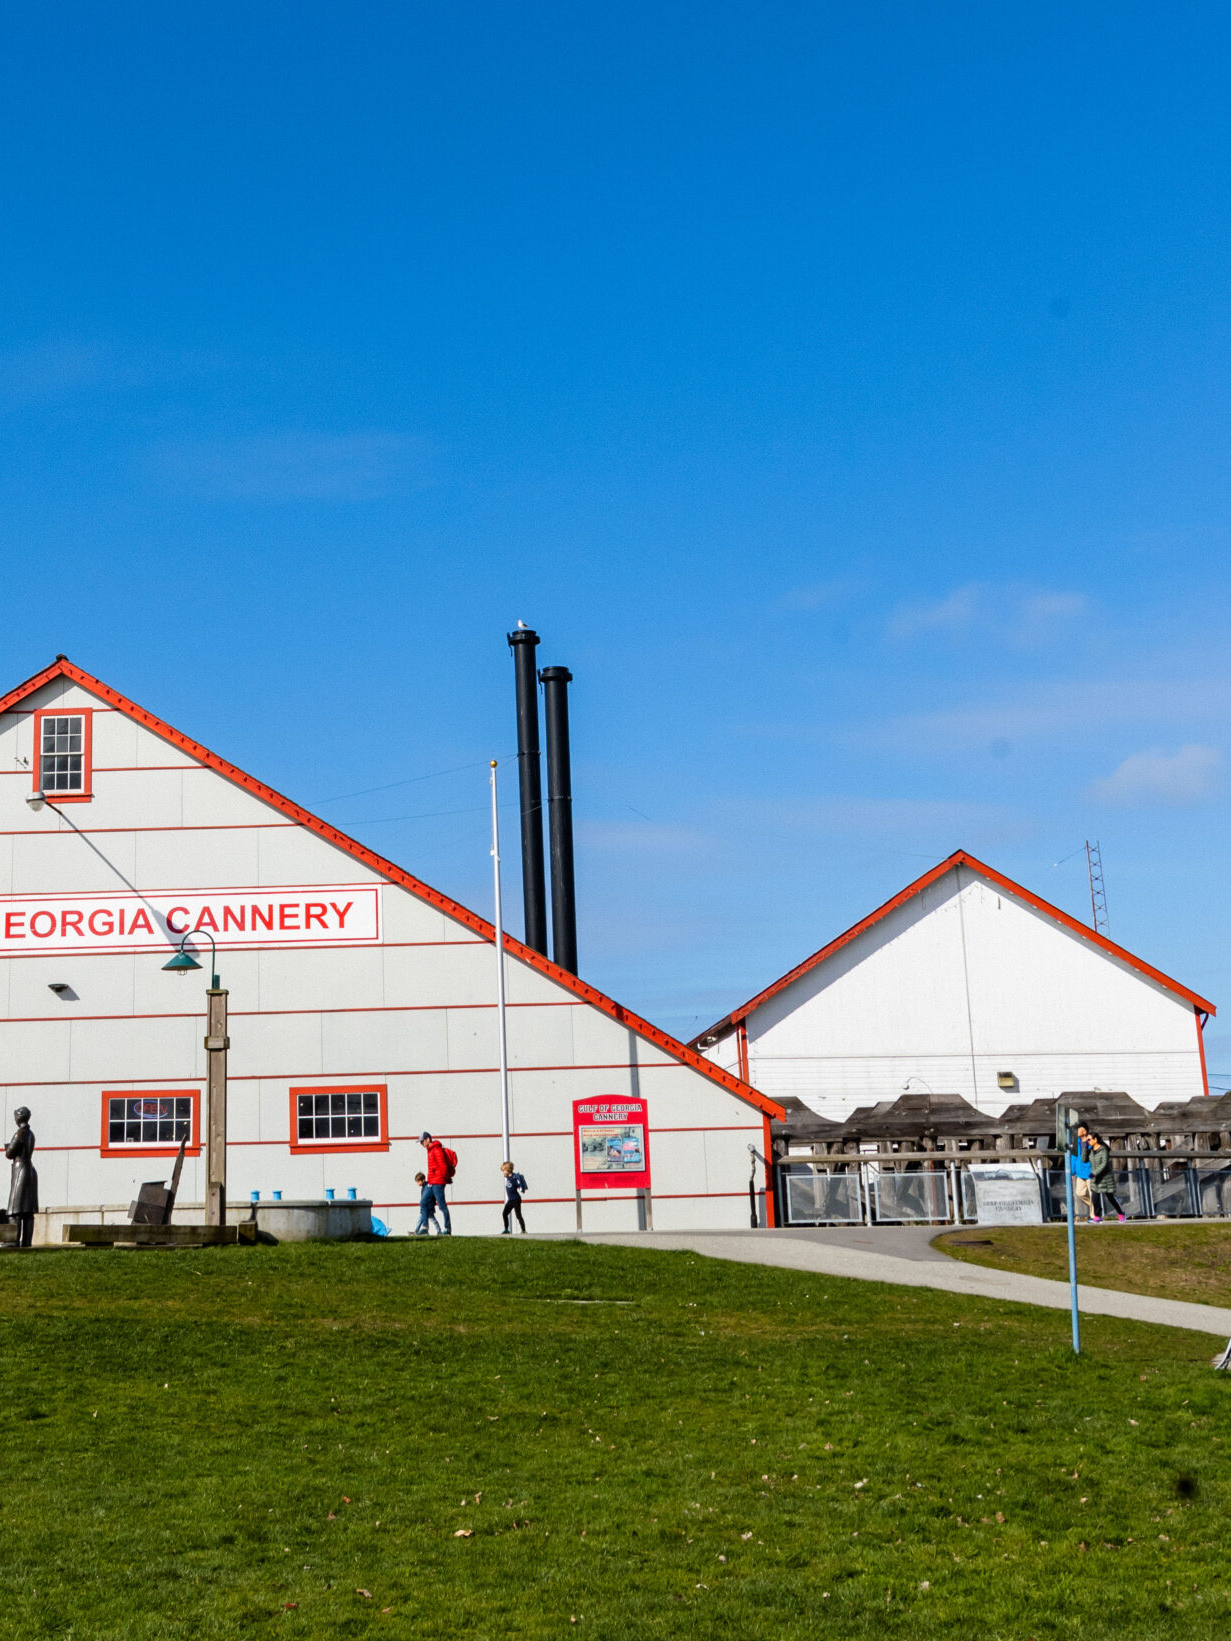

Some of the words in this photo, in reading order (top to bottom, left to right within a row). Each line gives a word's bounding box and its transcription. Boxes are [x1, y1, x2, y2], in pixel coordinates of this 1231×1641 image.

[166, 901, 354, 935] CANNERY
[578, 1105, 598, 1113] GULF
[599, 1104, 609, 1112] OF
[610, 1103, 643, 1112] GEORGIA
[593, 1112, 628, 1121] CANNERY
